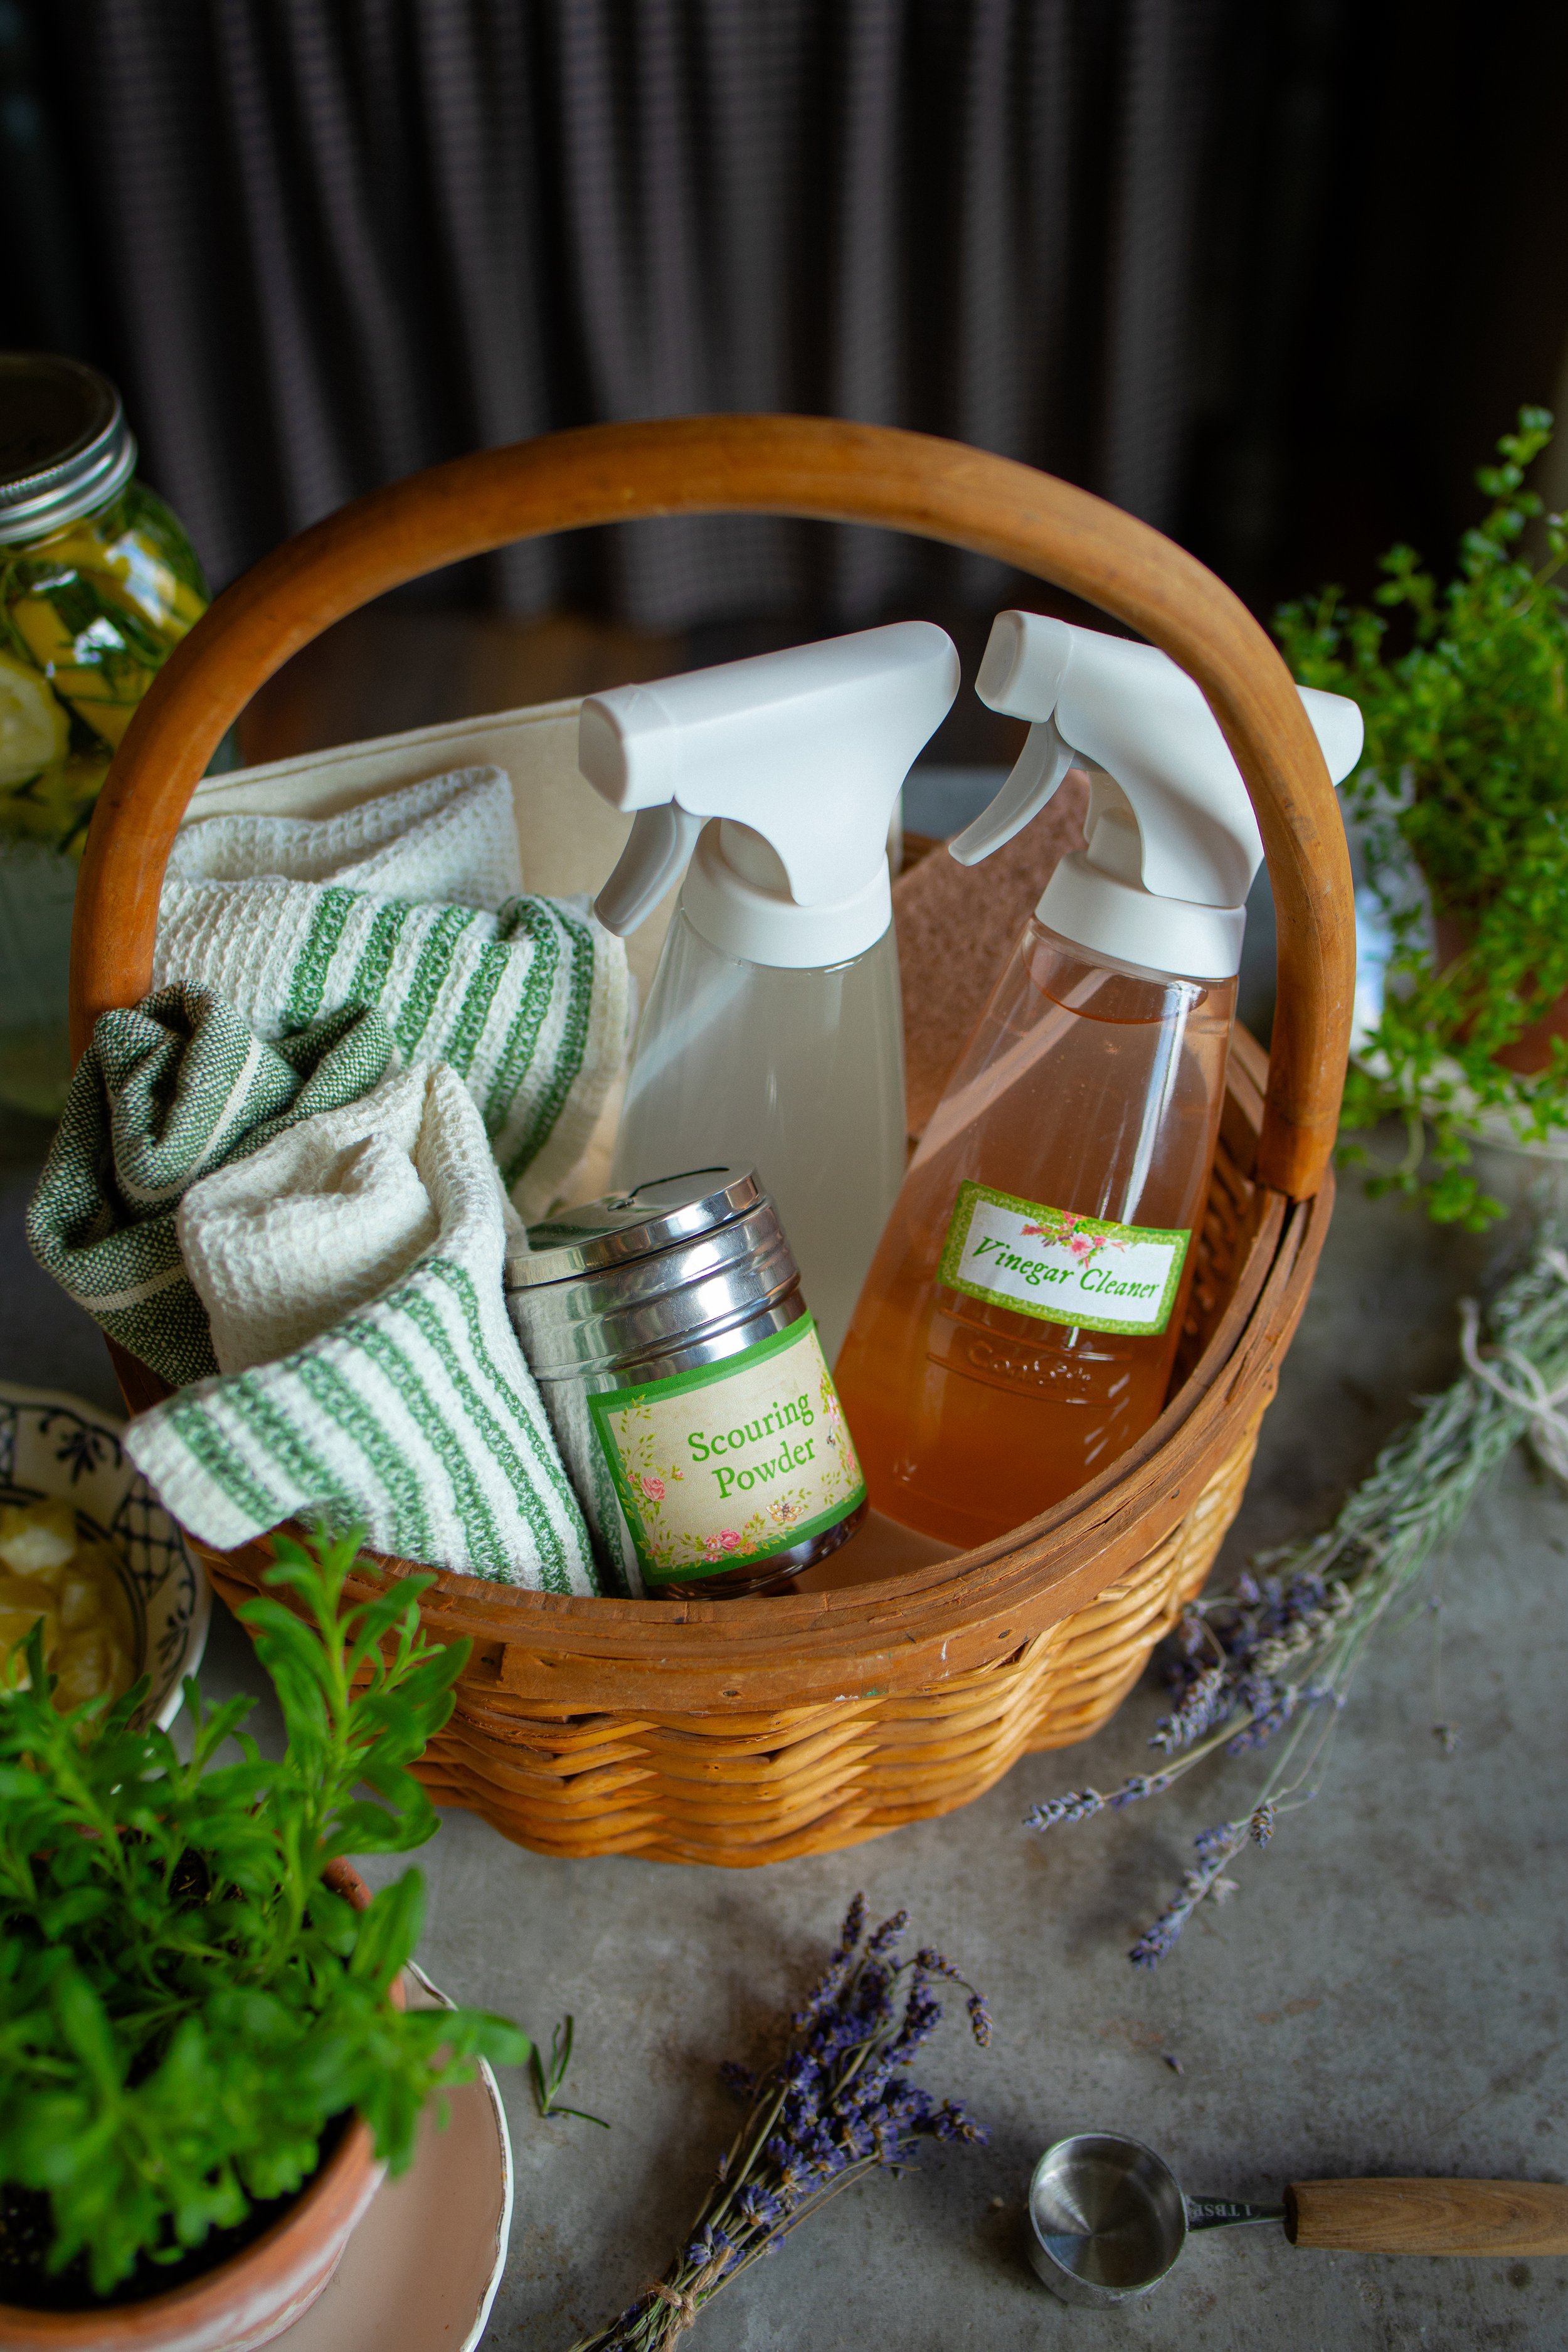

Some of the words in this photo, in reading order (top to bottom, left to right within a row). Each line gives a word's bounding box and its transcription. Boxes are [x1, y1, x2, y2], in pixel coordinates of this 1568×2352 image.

[973, 1236, 1074, 1286] Vinegar
[1079, 1268, 1160, 1299] Cleaner
[687, 1394, 815, 1462] Scouring
[712, 1438, 815, 1499] Powder
[1244, 2204, 1253, 2217] 1
